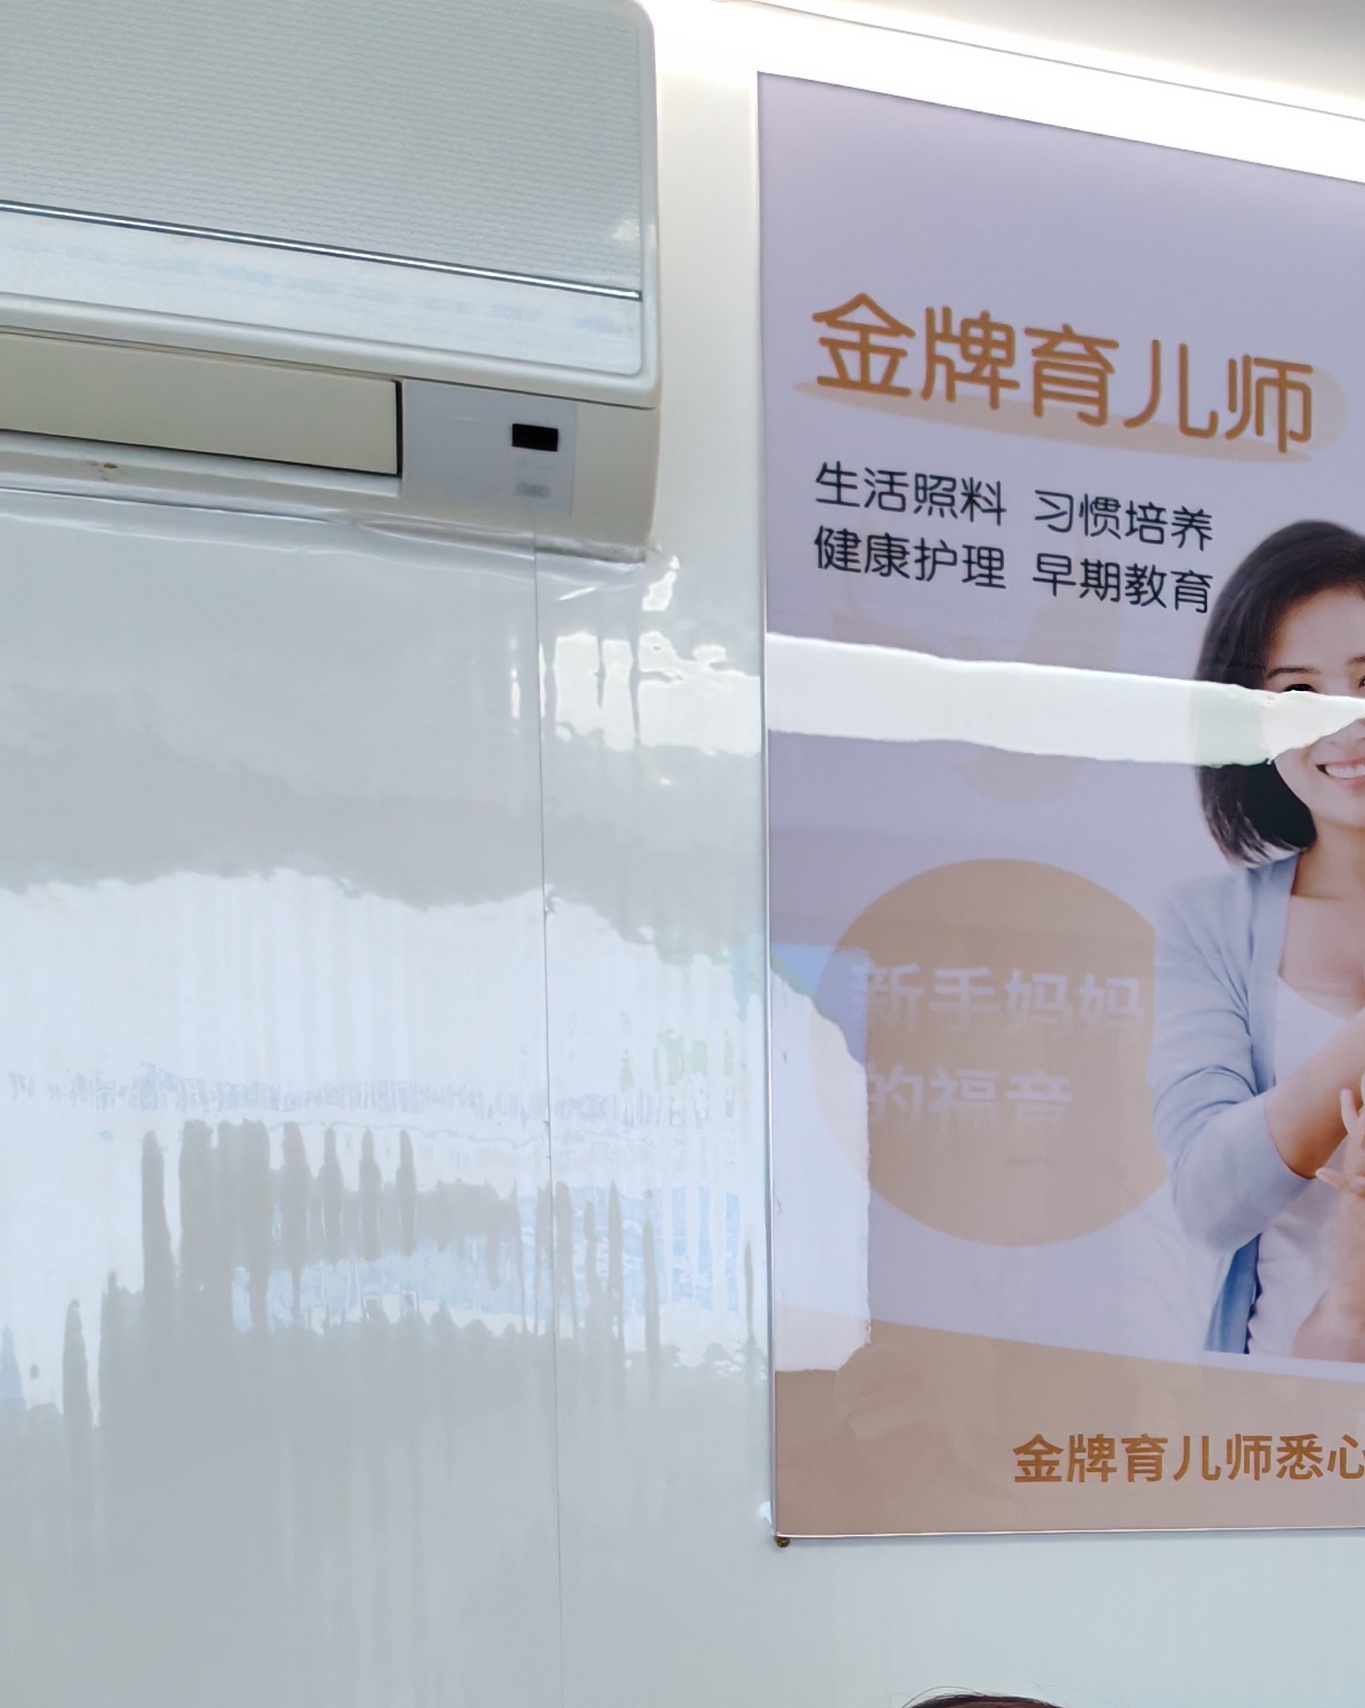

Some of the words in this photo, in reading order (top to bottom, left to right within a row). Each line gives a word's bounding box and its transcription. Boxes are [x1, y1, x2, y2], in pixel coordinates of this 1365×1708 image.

[811, 291, 1315, 454] 金牌育儿师
[813, 460, 1007, 527] 生活照料
[1034, 489, 1214, 552] 习惯培养
[813, 525, 1007, 590] 健康护理
[1031, 552, 1214, 614] 早期教育
[852, 963, 1144, 1039] 新手妈妈
